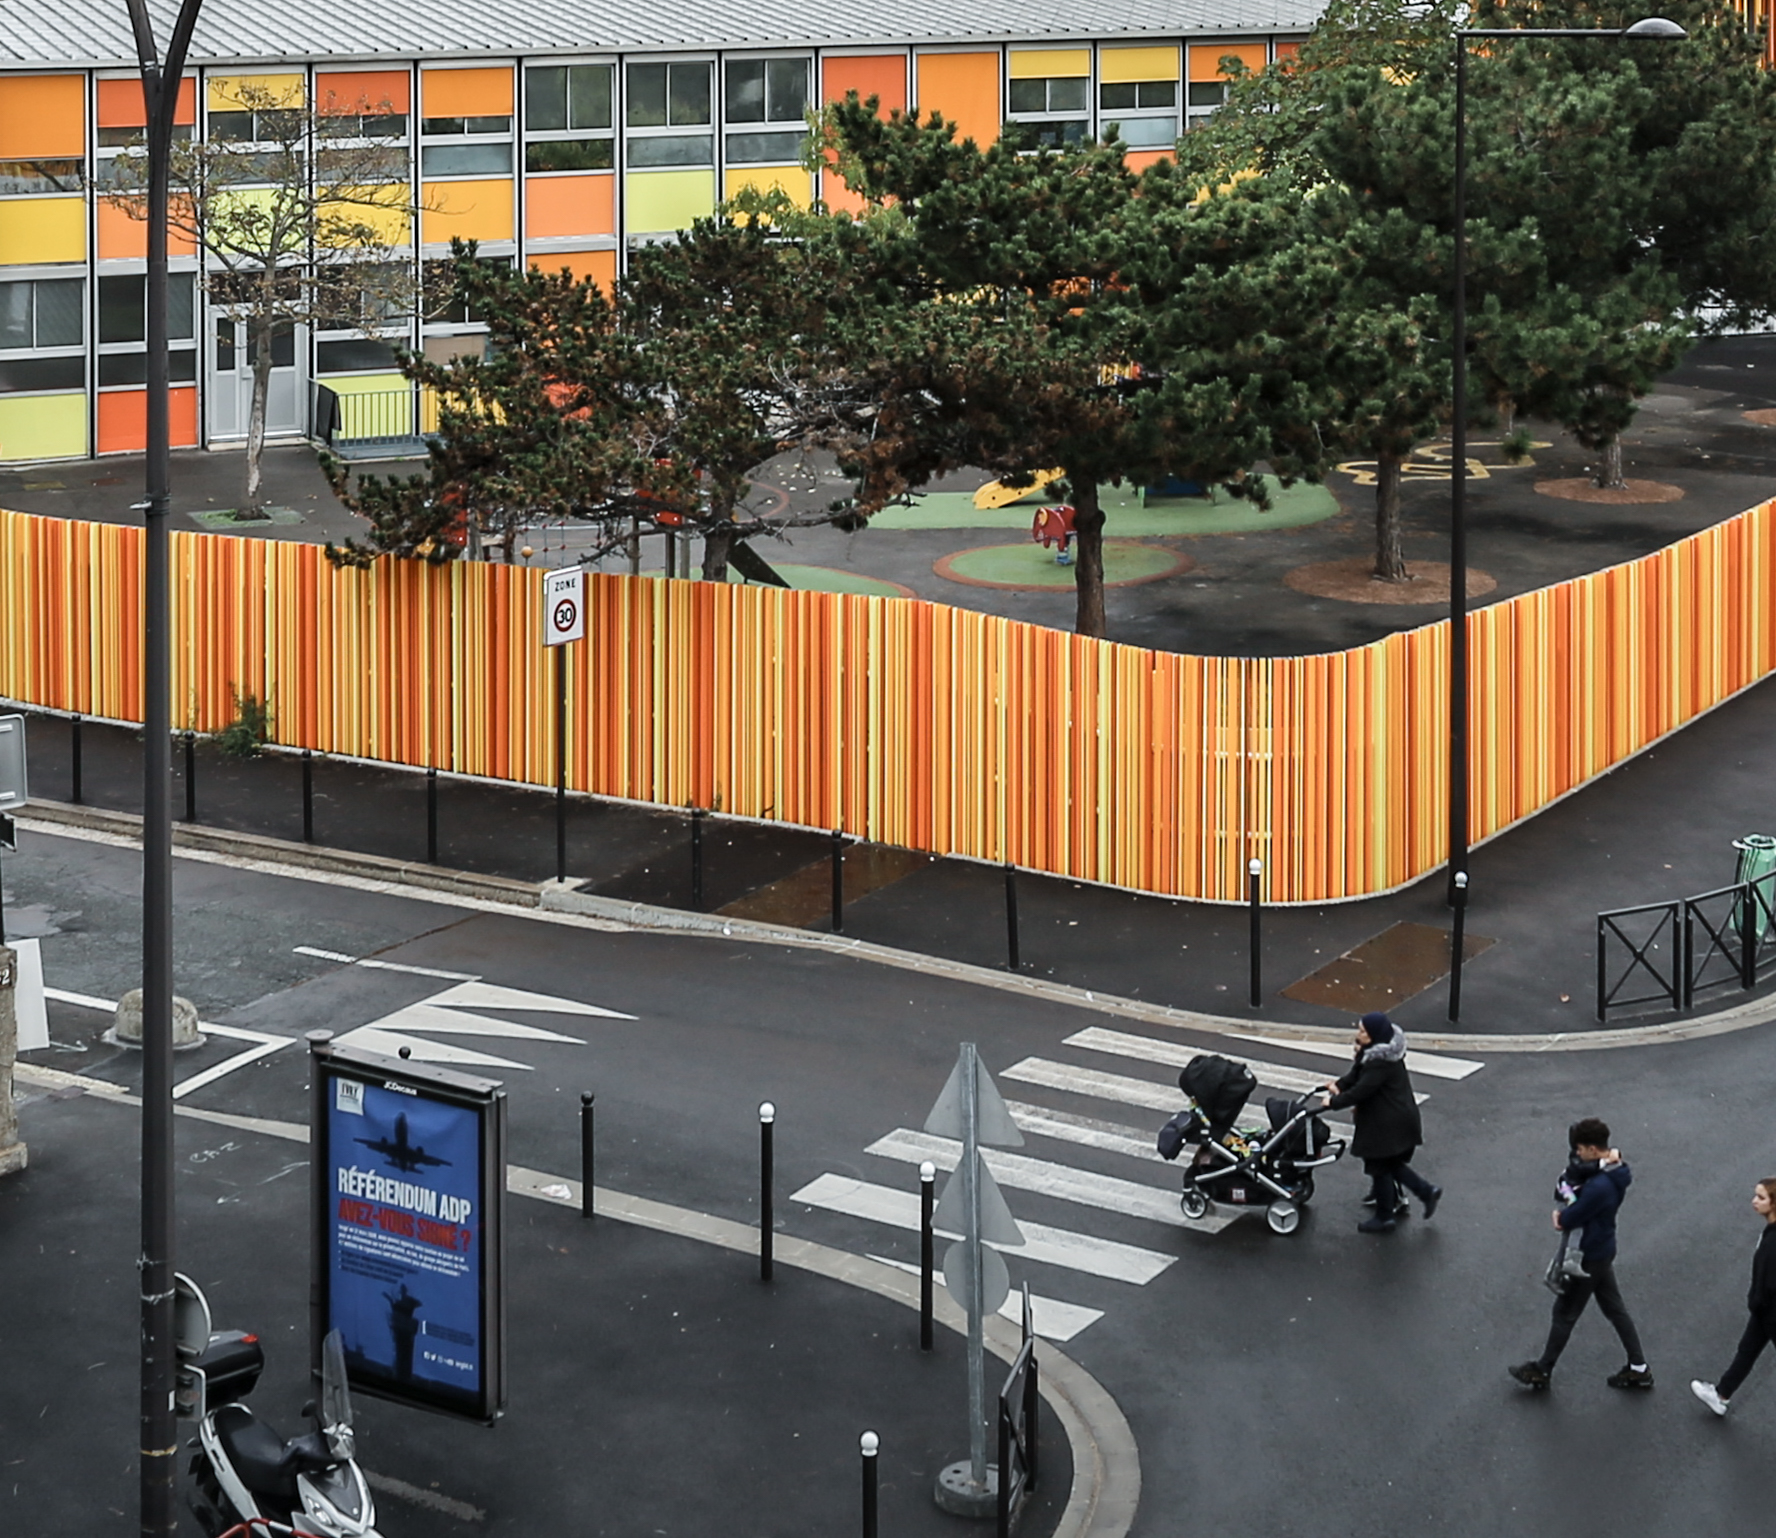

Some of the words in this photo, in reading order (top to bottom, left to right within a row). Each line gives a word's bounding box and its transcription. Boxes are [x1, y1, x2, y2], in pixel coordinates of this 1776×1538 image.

[555, 578, 576, 592] ZONE
[557, 607, 573, 624] 30
[338, 1165, 437, 1217] RÉFÉRENDUM
[439, 1194, 472, 1225] ADP
[338, 1198, 415, 1238] AVEZ-VOUS
[460, 1229, 472, 1252] ?
